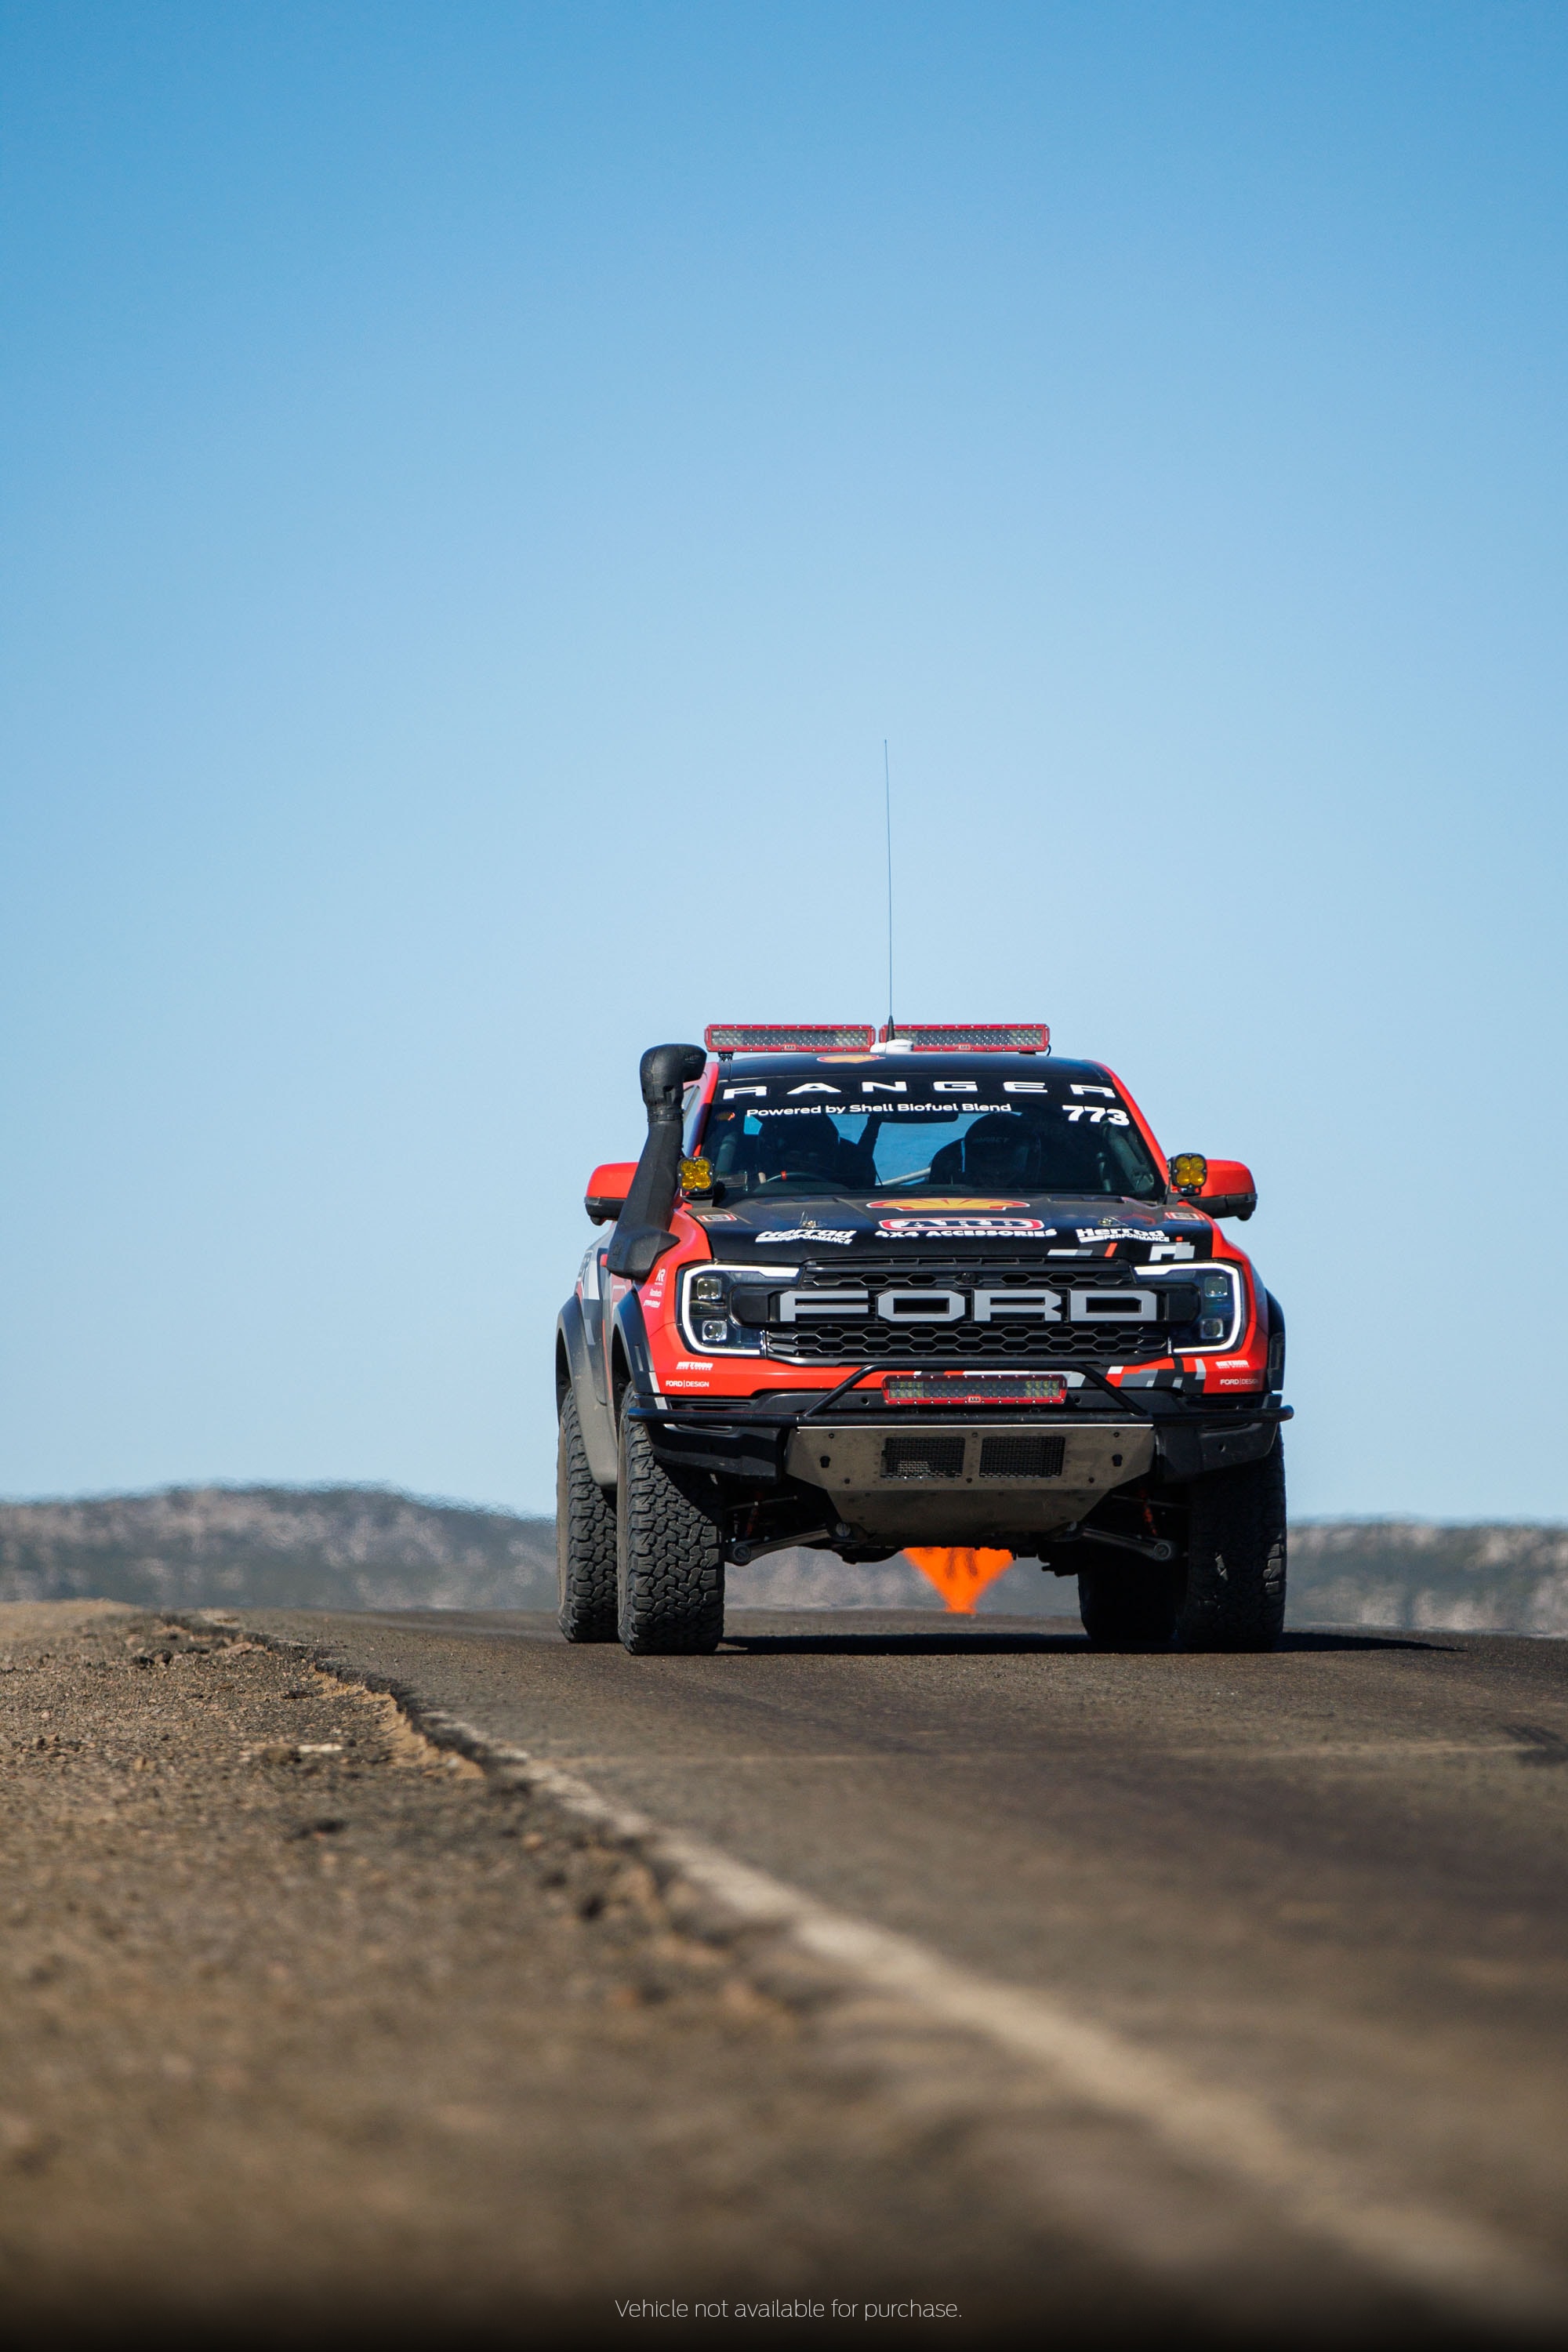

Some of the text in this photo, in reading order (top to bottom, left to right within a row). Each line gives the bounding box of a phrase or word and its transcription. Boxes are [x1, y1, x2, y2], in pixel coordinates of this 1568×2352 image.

[722, 1081, 1116, 1100] RANGER
[746, 1103, 1012, 1117] Powered by Shell Biofuel Blend
[1062, 1105, 1131, 1127] 773
[925, 1229, 1058, 1238] ACCESSORIES
[1075, 1228, 1166, 1238] Herrod
[1104, 1233, 1171, 1243] PERFORMANCE
[779, 1289, 1158, 1323] FORD
